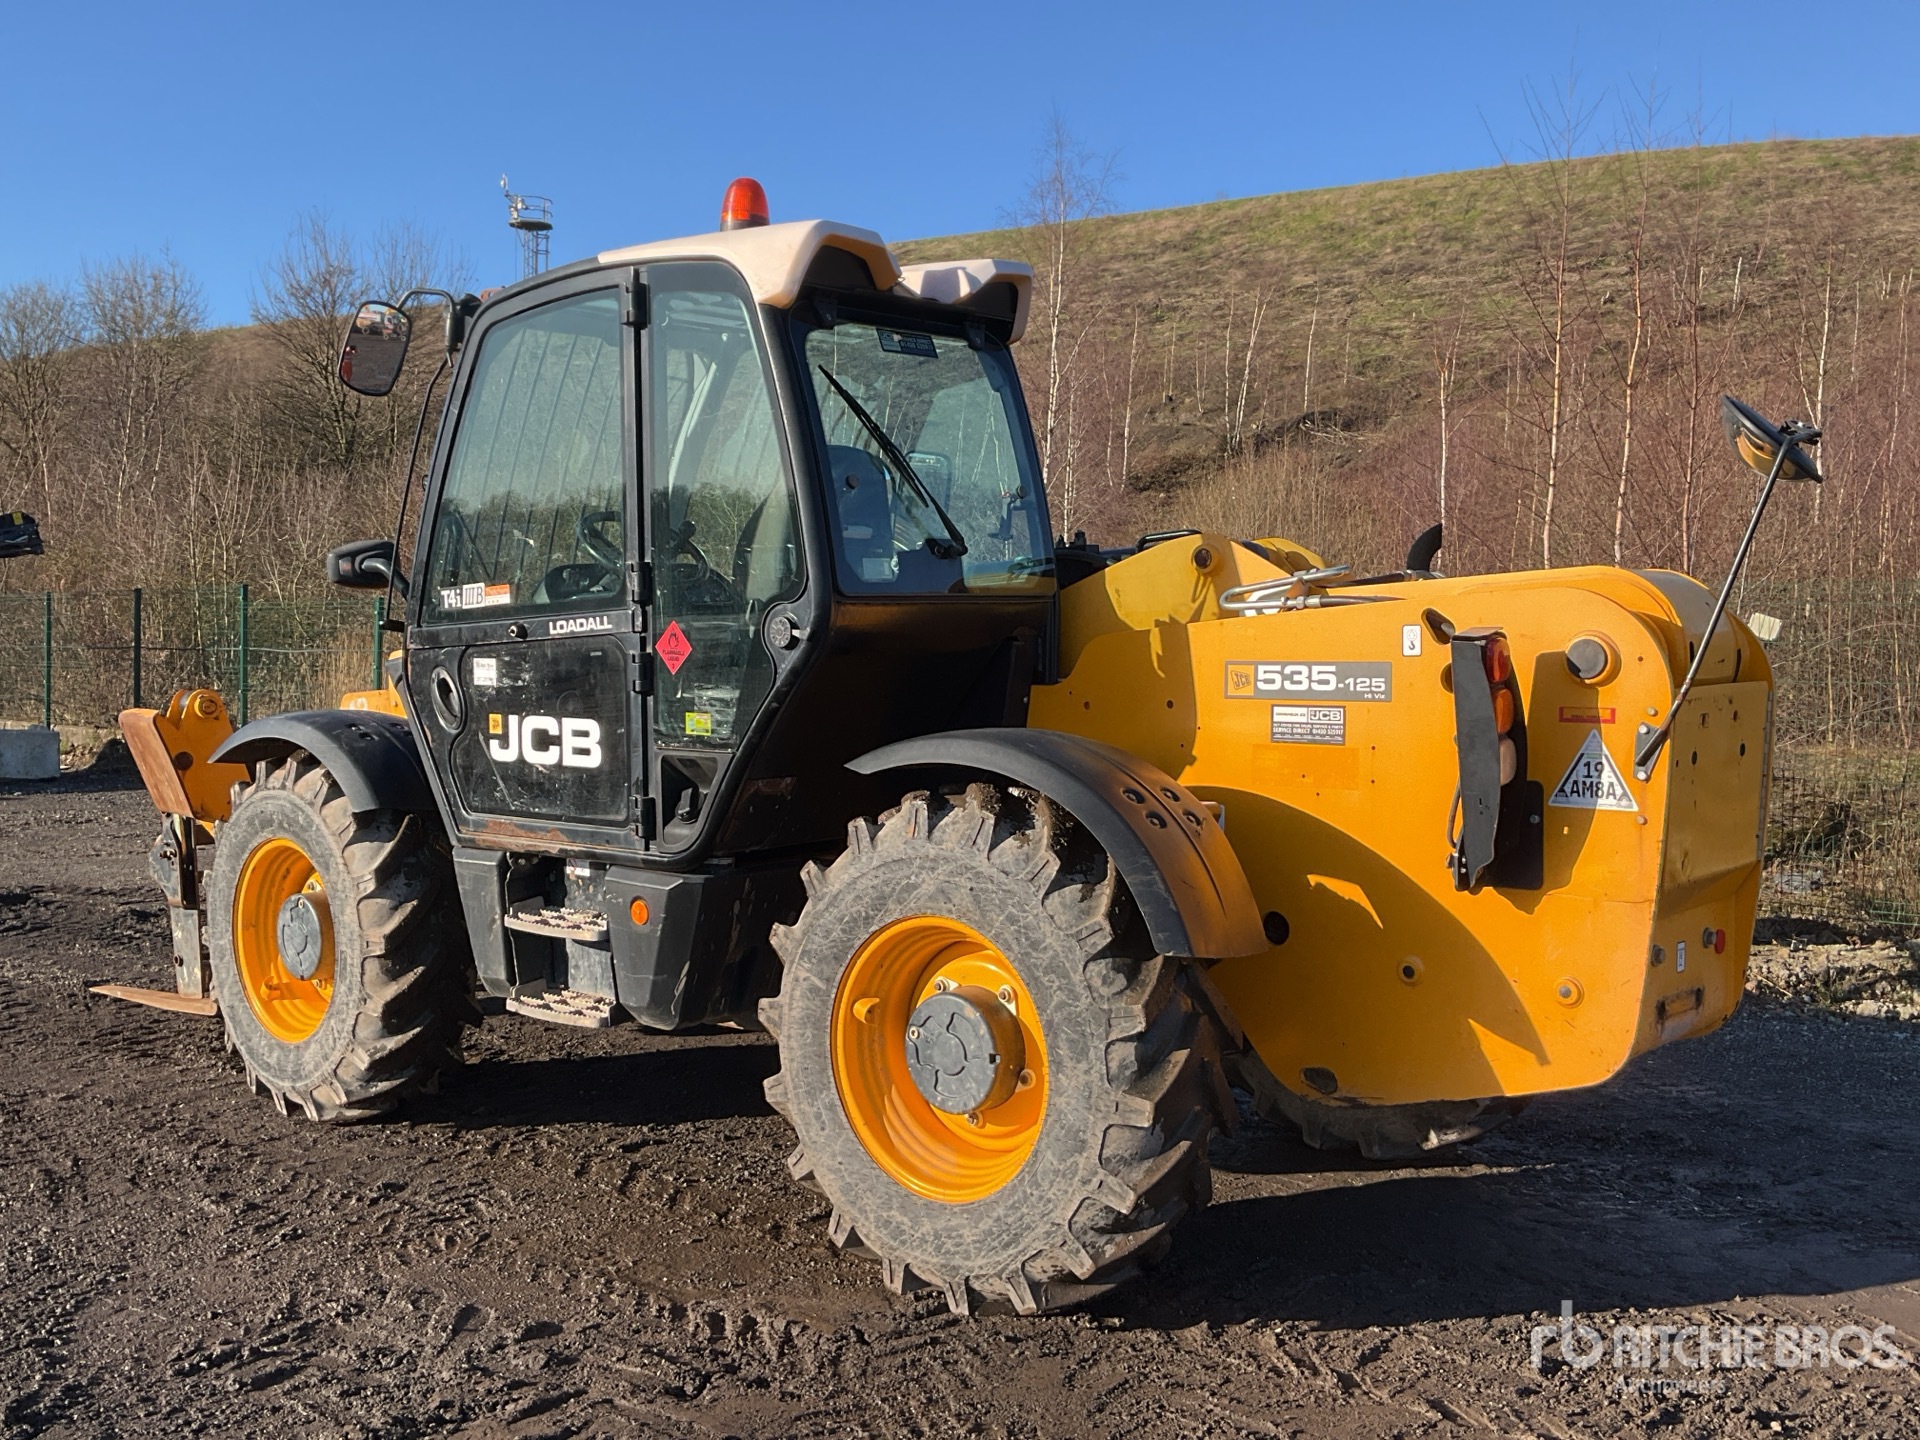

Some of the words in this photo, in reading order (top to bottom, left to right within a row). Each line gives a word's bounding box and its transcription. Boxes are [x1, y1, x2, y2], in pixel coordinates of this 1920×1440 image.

[441, 589, 461, 608] T4i
[549, 616, 613, 634] LOADALL
[1231, 670, 1251, 690] JCB
[1257, 665, 1386, 692] 535-125
[1310, 710, 1341, 721] JCB
[489, 714, 602, 769] JCB
[1583, 761, 1605, 780] 19
[1570, 780, 1617, 800] AM8A
